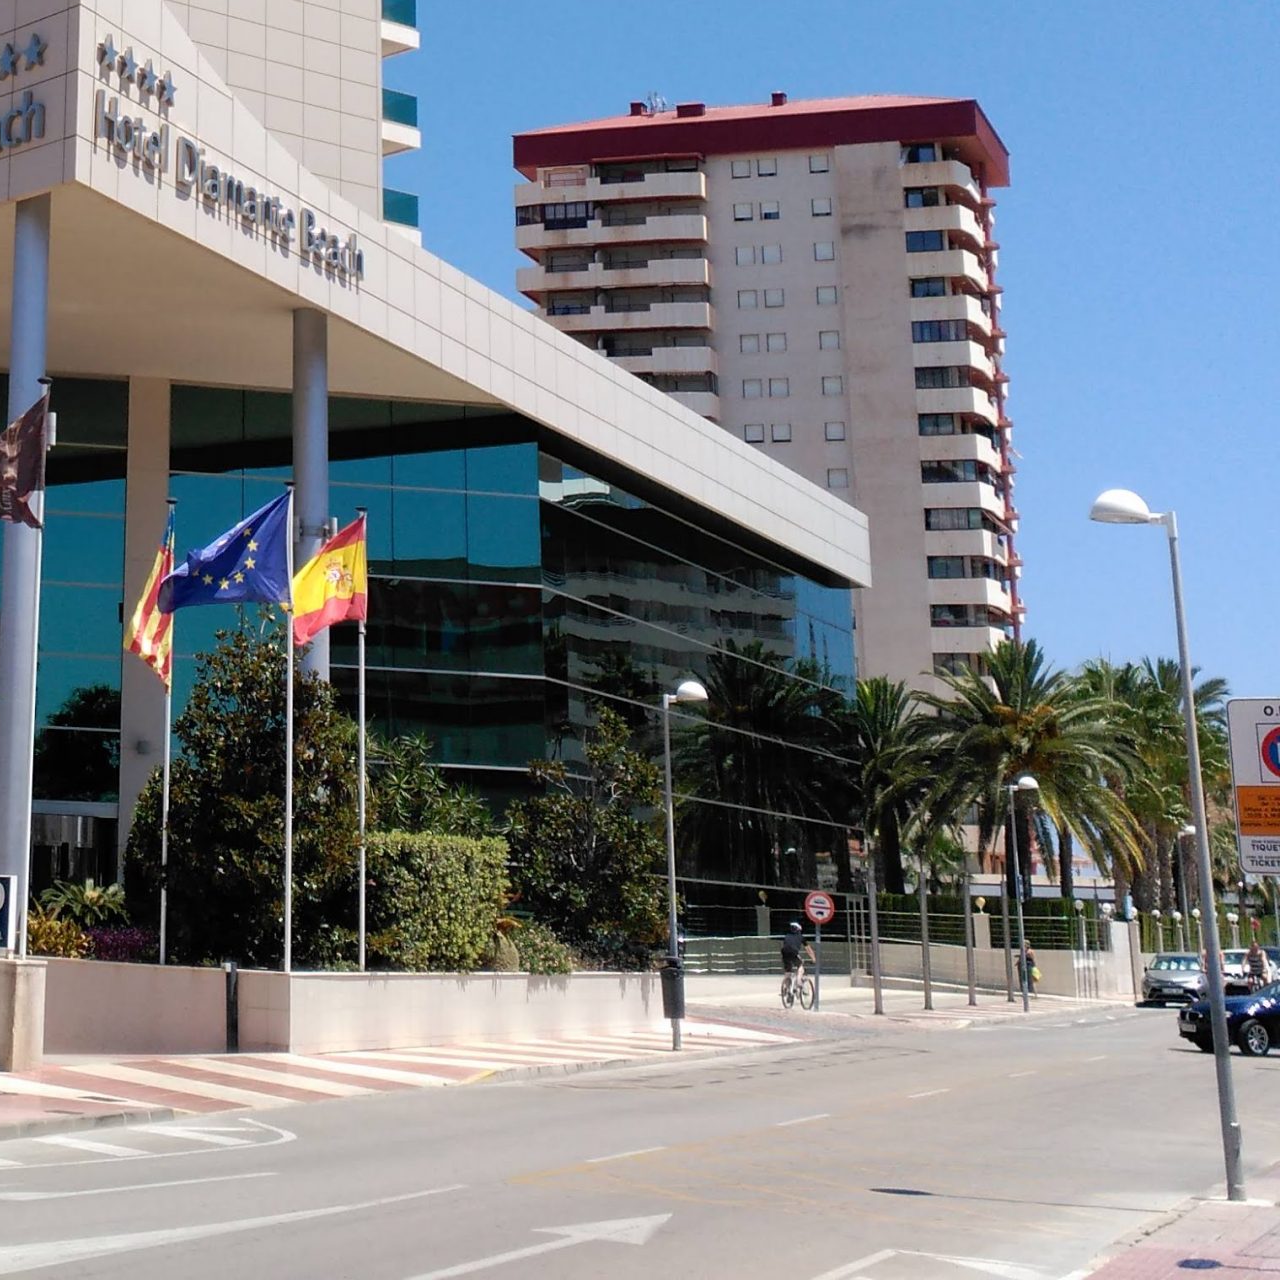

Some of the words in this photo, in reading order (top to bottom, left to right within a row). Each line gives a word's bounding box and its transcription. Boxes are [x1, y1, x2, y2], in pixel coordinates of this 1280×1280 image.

[95, 89, 169, 174] Hotel
[176, 136, 296, 242] Diamante
[299, 207, 364, 281] Beach
[1263, 704, 1280, 717] O.
